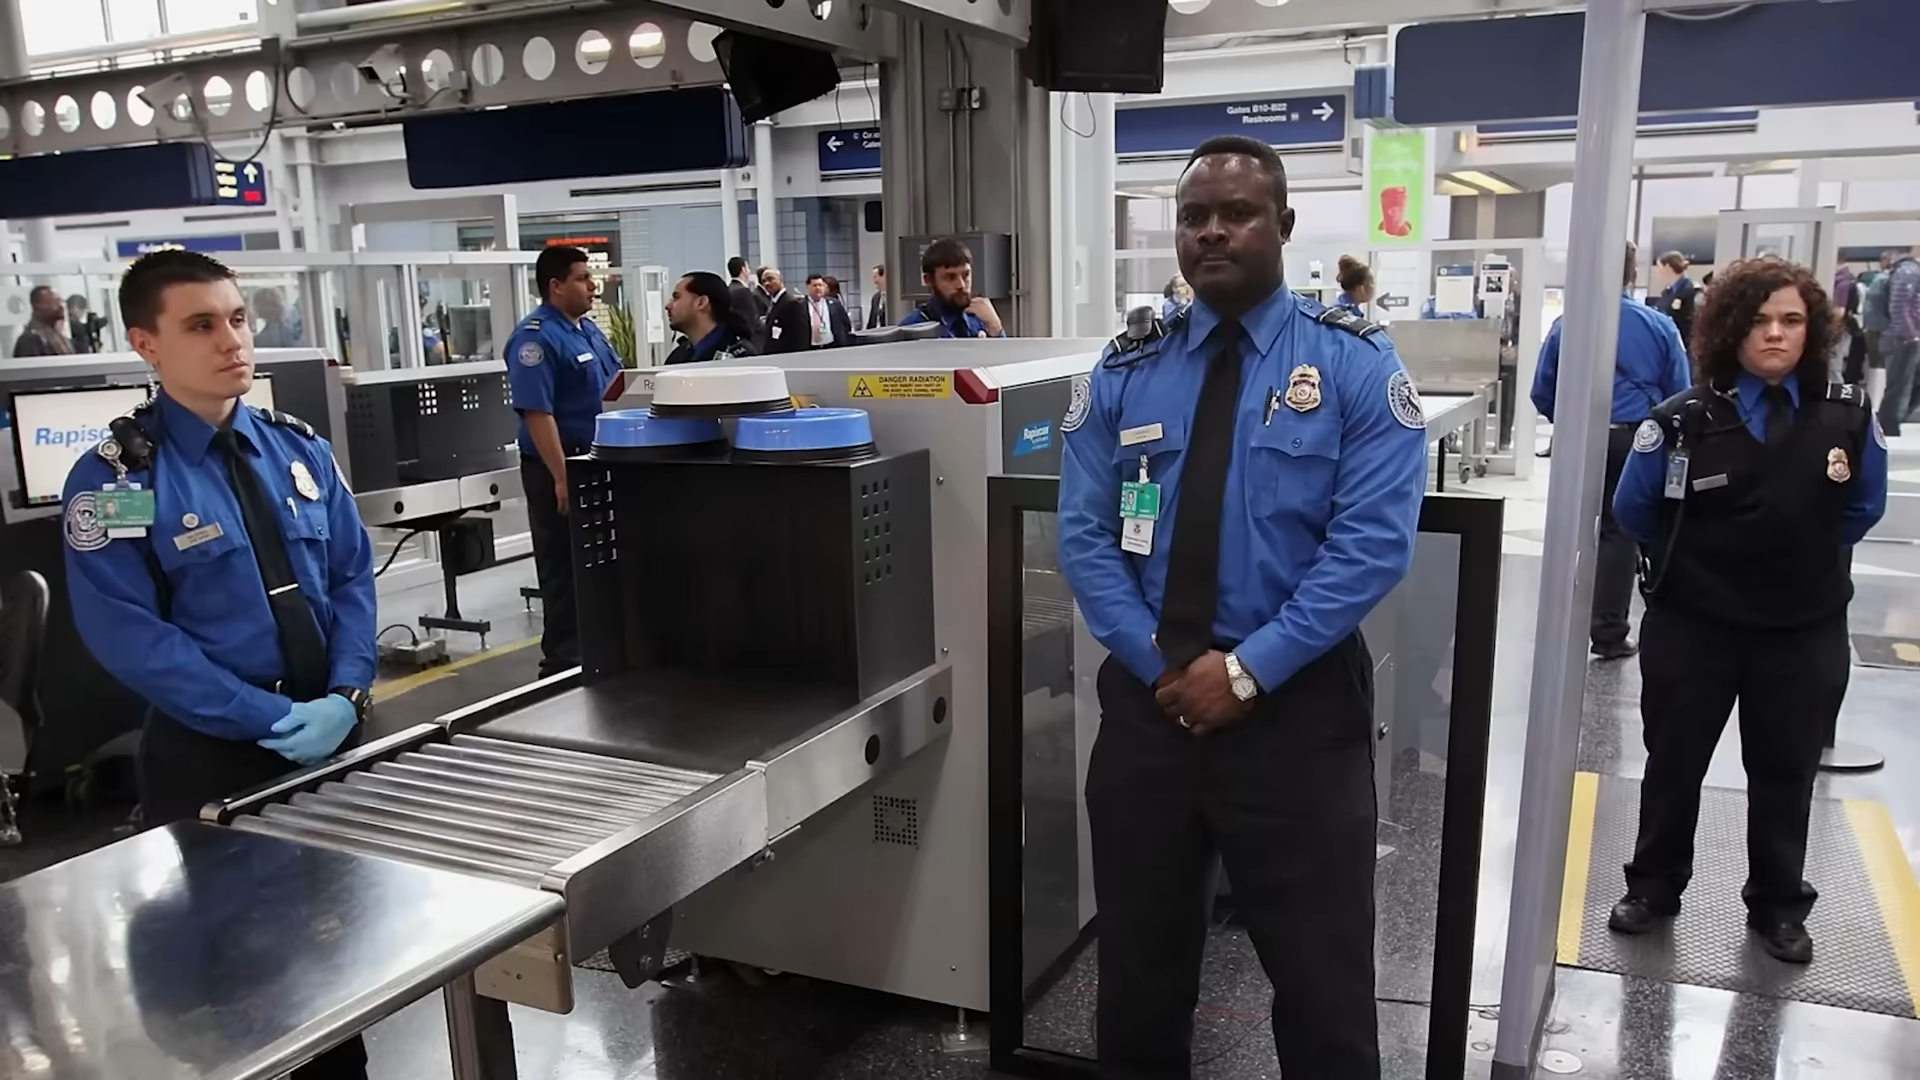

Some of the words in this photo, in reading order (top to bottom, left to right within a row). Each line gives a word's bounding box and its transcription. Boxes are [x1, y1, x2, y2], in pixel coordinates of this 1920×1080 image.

[1226, 105, 1251, 115] Gates
[1252, 102, 1287, 113] B10-B22
[1242, 114, 1287, 124] Restrooms
[35, 424, 111, 448] Rapisc
[1023, 426, 1050, 441] Rapiscan
